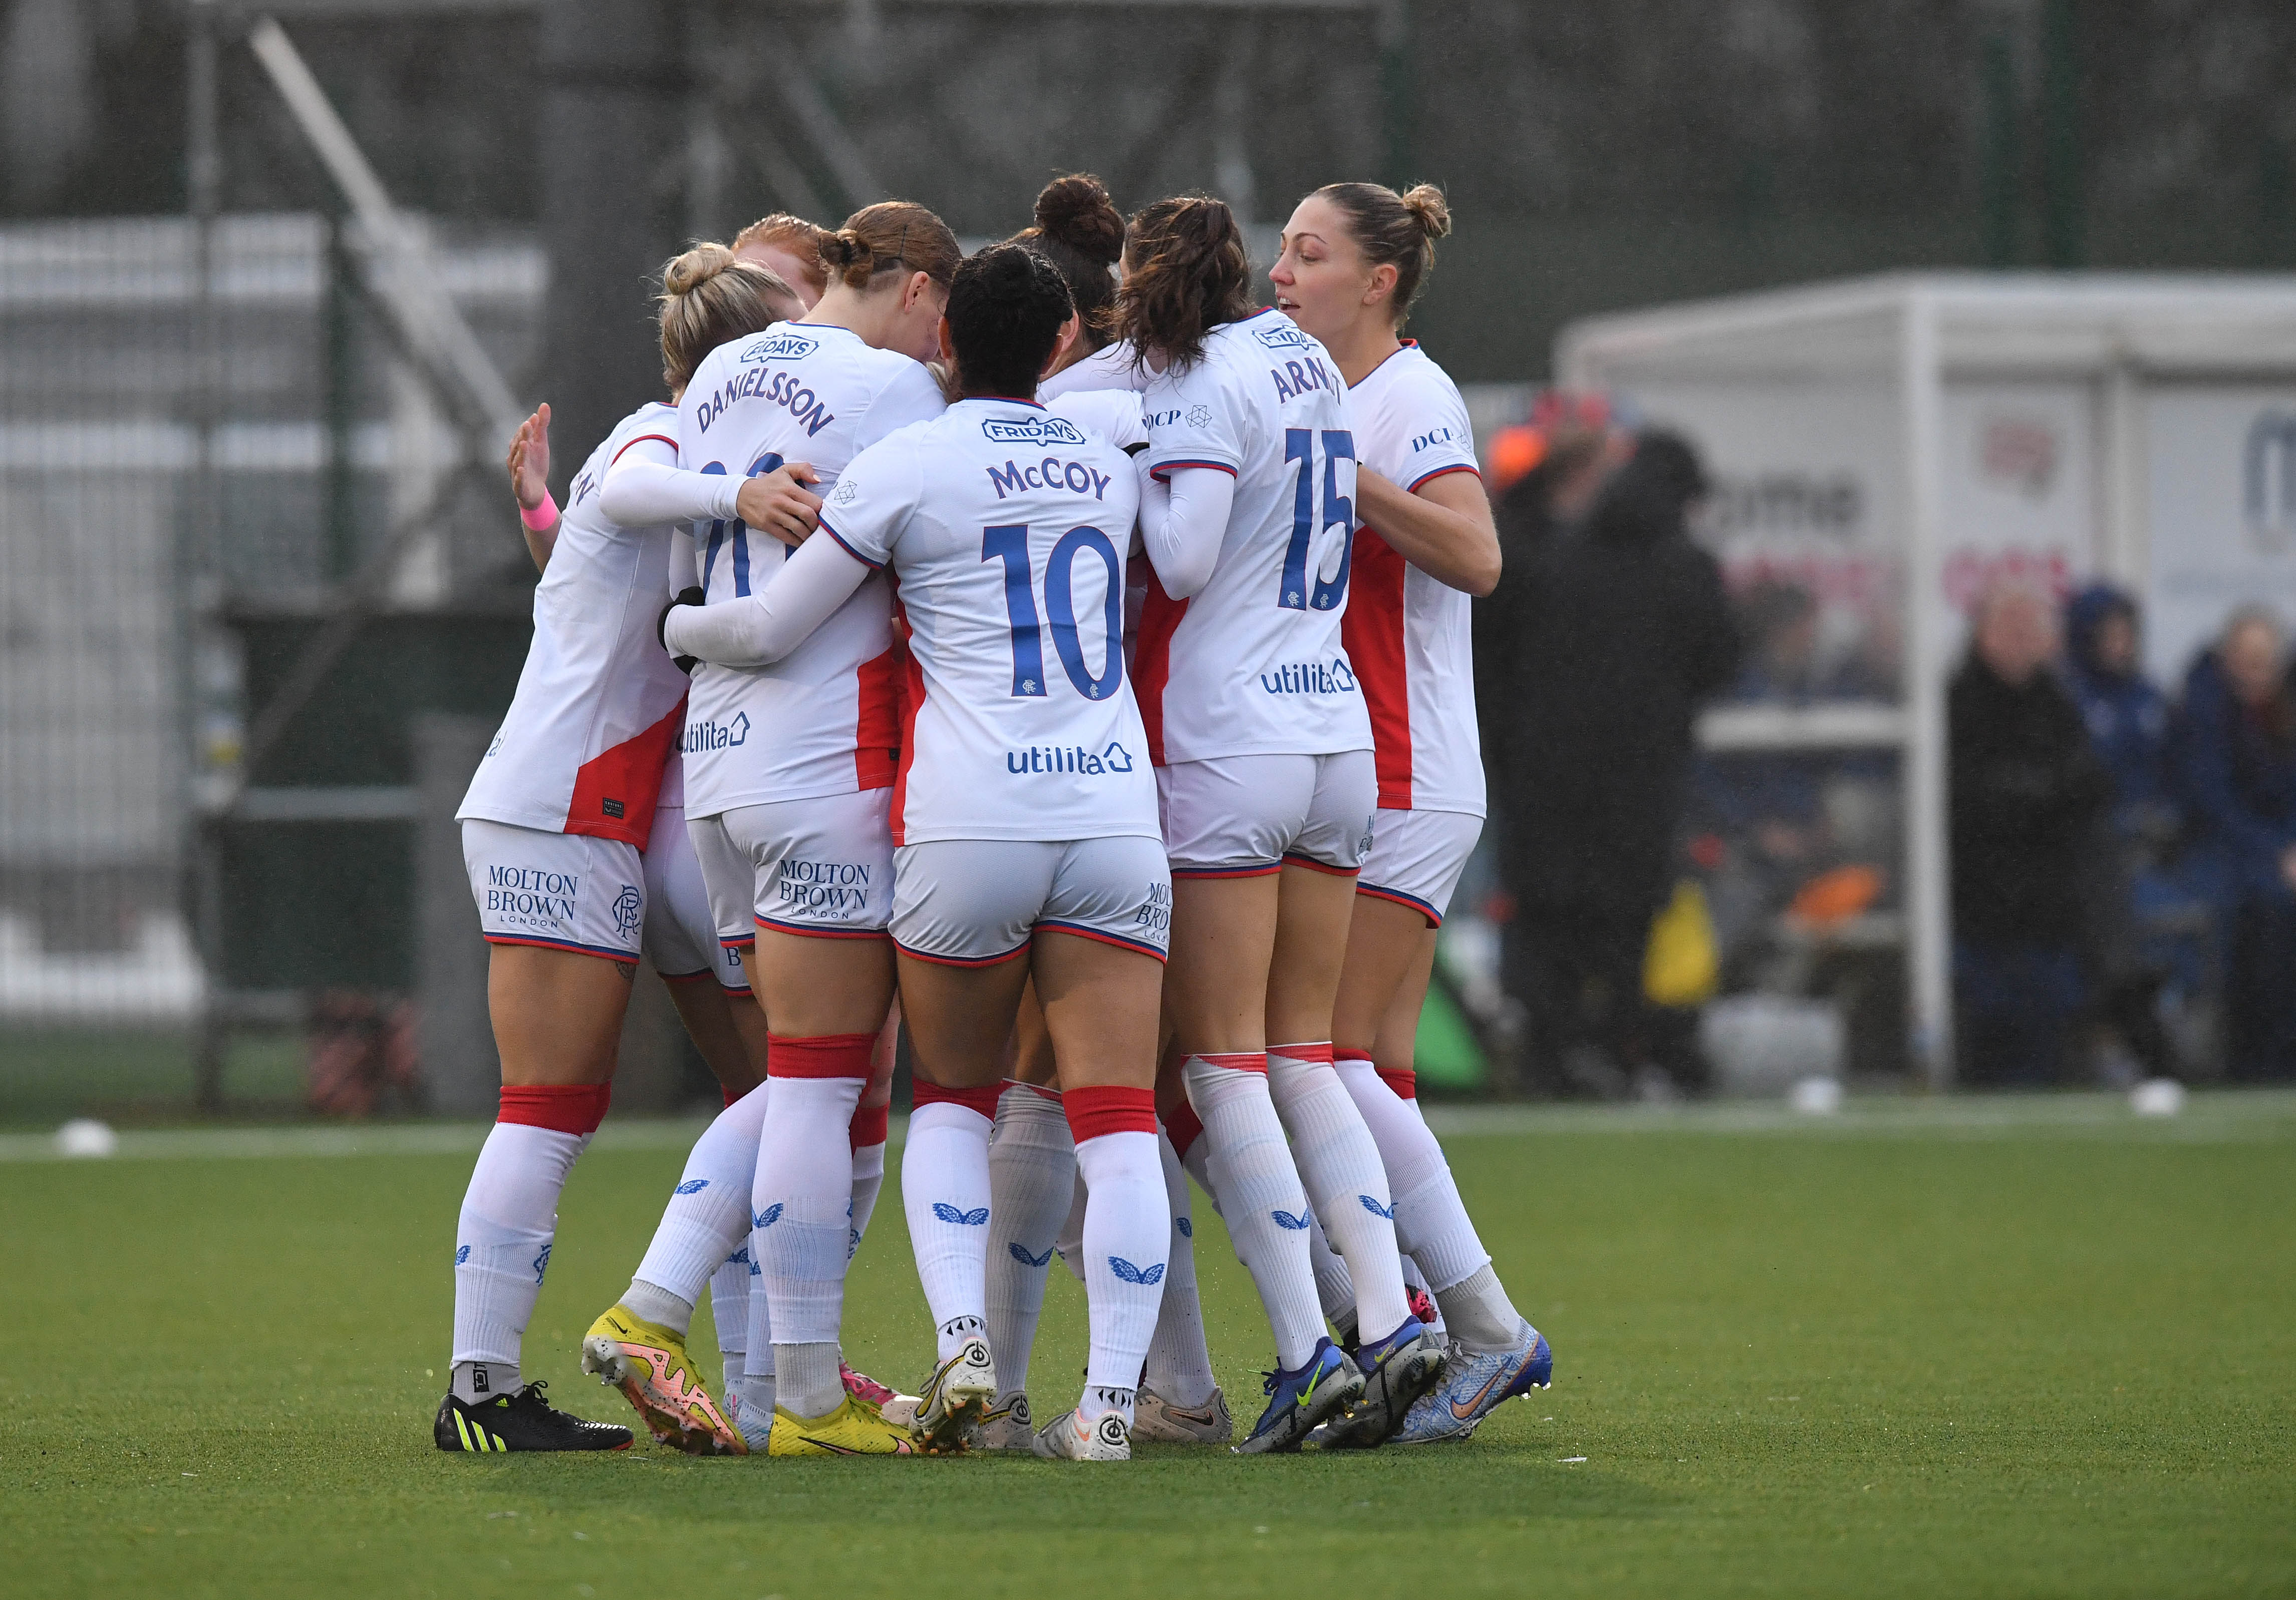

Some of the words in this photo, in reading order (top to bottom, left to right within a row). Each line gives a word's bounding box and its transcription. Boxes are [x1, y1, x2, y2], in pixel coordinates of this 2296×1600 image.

[1259, 331, 1309, 344] FIDA
[697, 367, 835, 438] DANIELSSON
[993, 423, 1077, 441] FRIDAYS
[985, 457, 1112, 501] McCOY
[1278, 428, 1356, 611] 15
[981, 524, 1124, 701] 10
[1261, 664, 1335, 695] utilita
[1007, 746, 1106, 775] utilita
[488, 865, 578, 897] MOLTON
[779, 859, 871, 885] MOLTON
[487, 889, 576, 920] BROWN
[779, 879, 869, 909] BROWN
[1150, 882, 1172, 906] MOL
[500, 914, 558, 928] LONDON
[790, 906, 849, 919] LONDON
[1134, 904, 1169, 930] BRO
